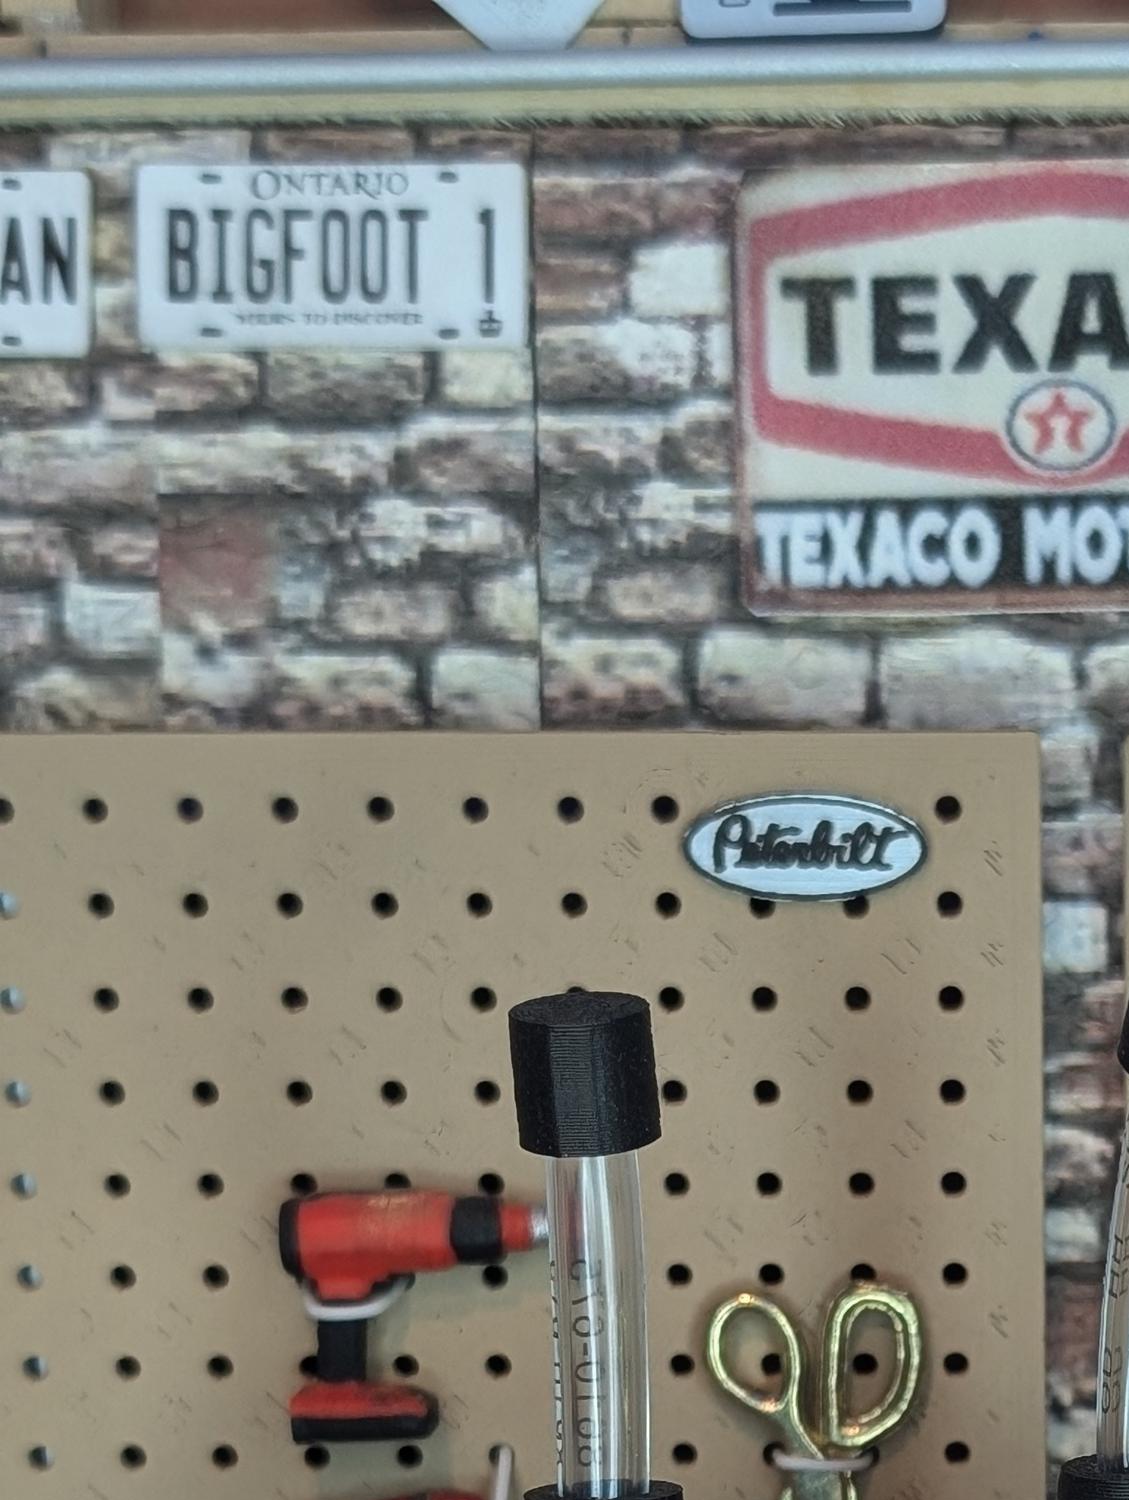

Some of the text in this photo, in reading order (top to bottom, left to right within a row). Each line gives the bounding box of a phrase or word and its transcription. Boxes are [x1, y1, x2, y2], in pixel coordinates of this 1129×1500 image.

[167, 208, 497, 304] BIGFOOT 1
[754, 507, 1000, 588] TEXACO
